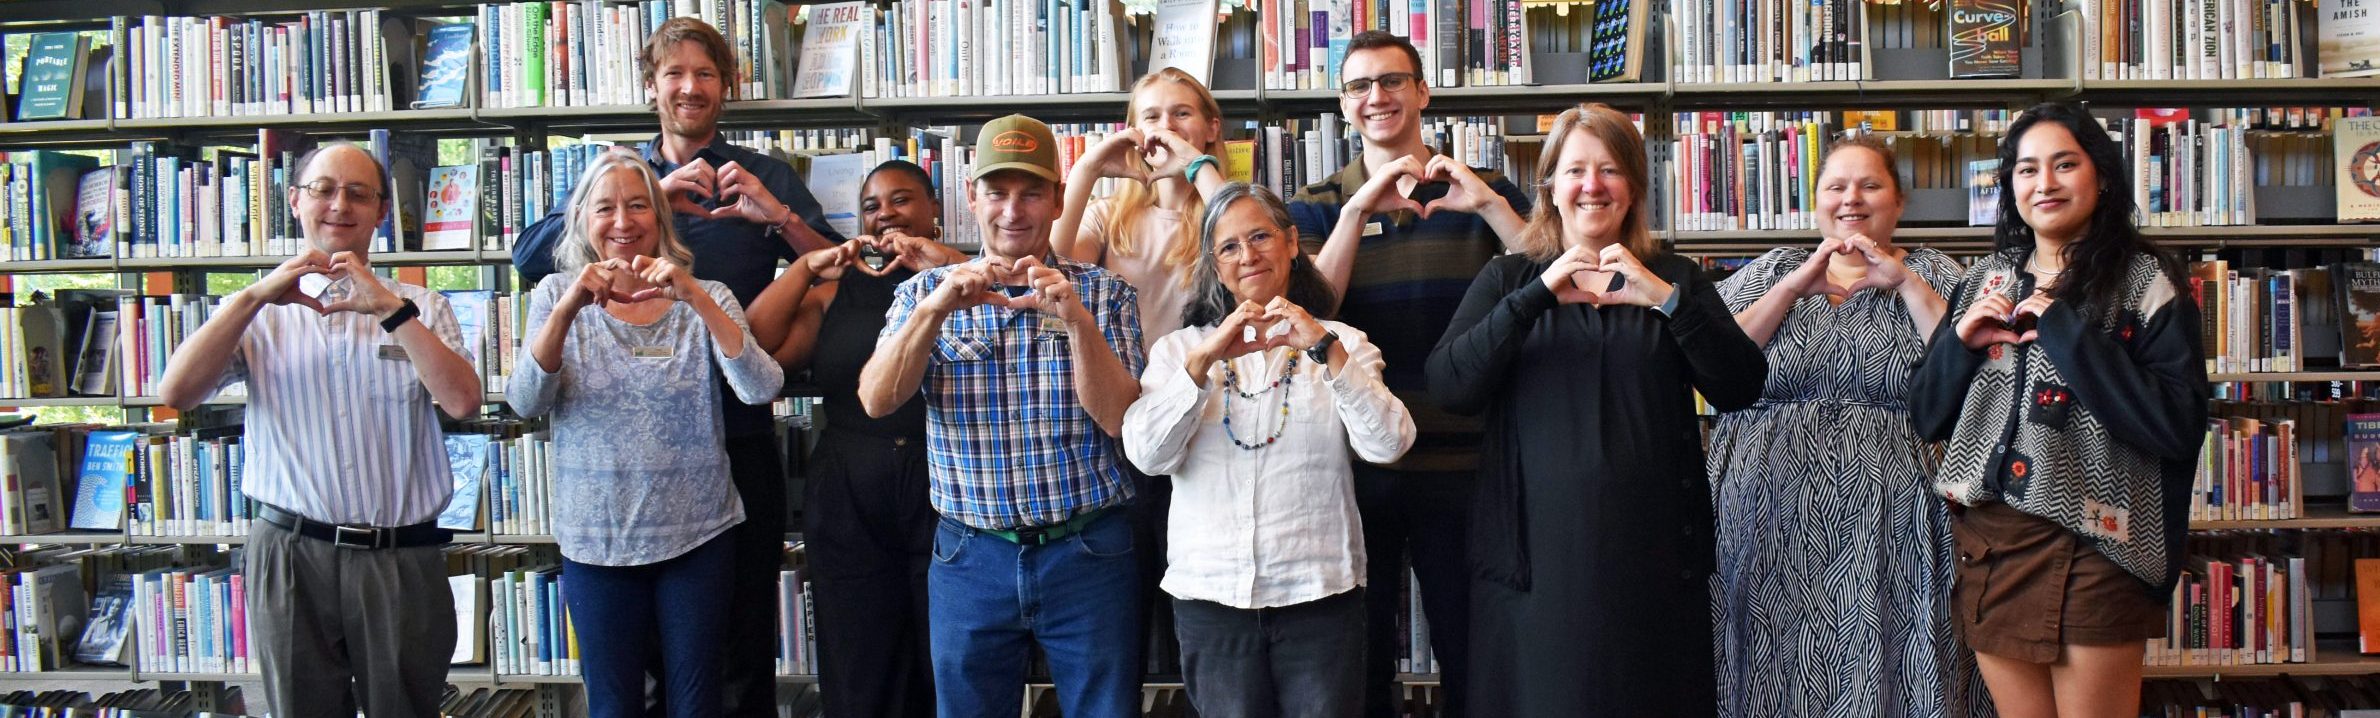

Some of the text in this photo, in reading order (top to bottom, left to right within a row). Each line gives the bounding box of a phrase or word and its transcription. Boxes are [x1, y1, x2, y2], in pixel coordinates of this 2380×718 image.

[831, 6, 860, 23] REAL
[2332, 9, 2367, 20] AMISH
[530, 7, 540, 59] On the Edge
[596, 12, 604, 47] mindset
[1509, 1, 1517, 67] KIERKEGAARD
[1976, 26, 2009, 42] ball
[232, 35, 242, 71] SPOOK
[961, 41, 969, 62] Quit
[2204, 36, 2216, 57] ZION
[36, 56, 68, 67] PORTABLE
[172, 37, 181, 80] EXTENDED
[2348, 121, 2371, 130] THE
[139, 197, 145, 208] OF
[250, 165, 259, 223] WHITE MAGIC
[805, 586, 815, 642] HAPPIER
